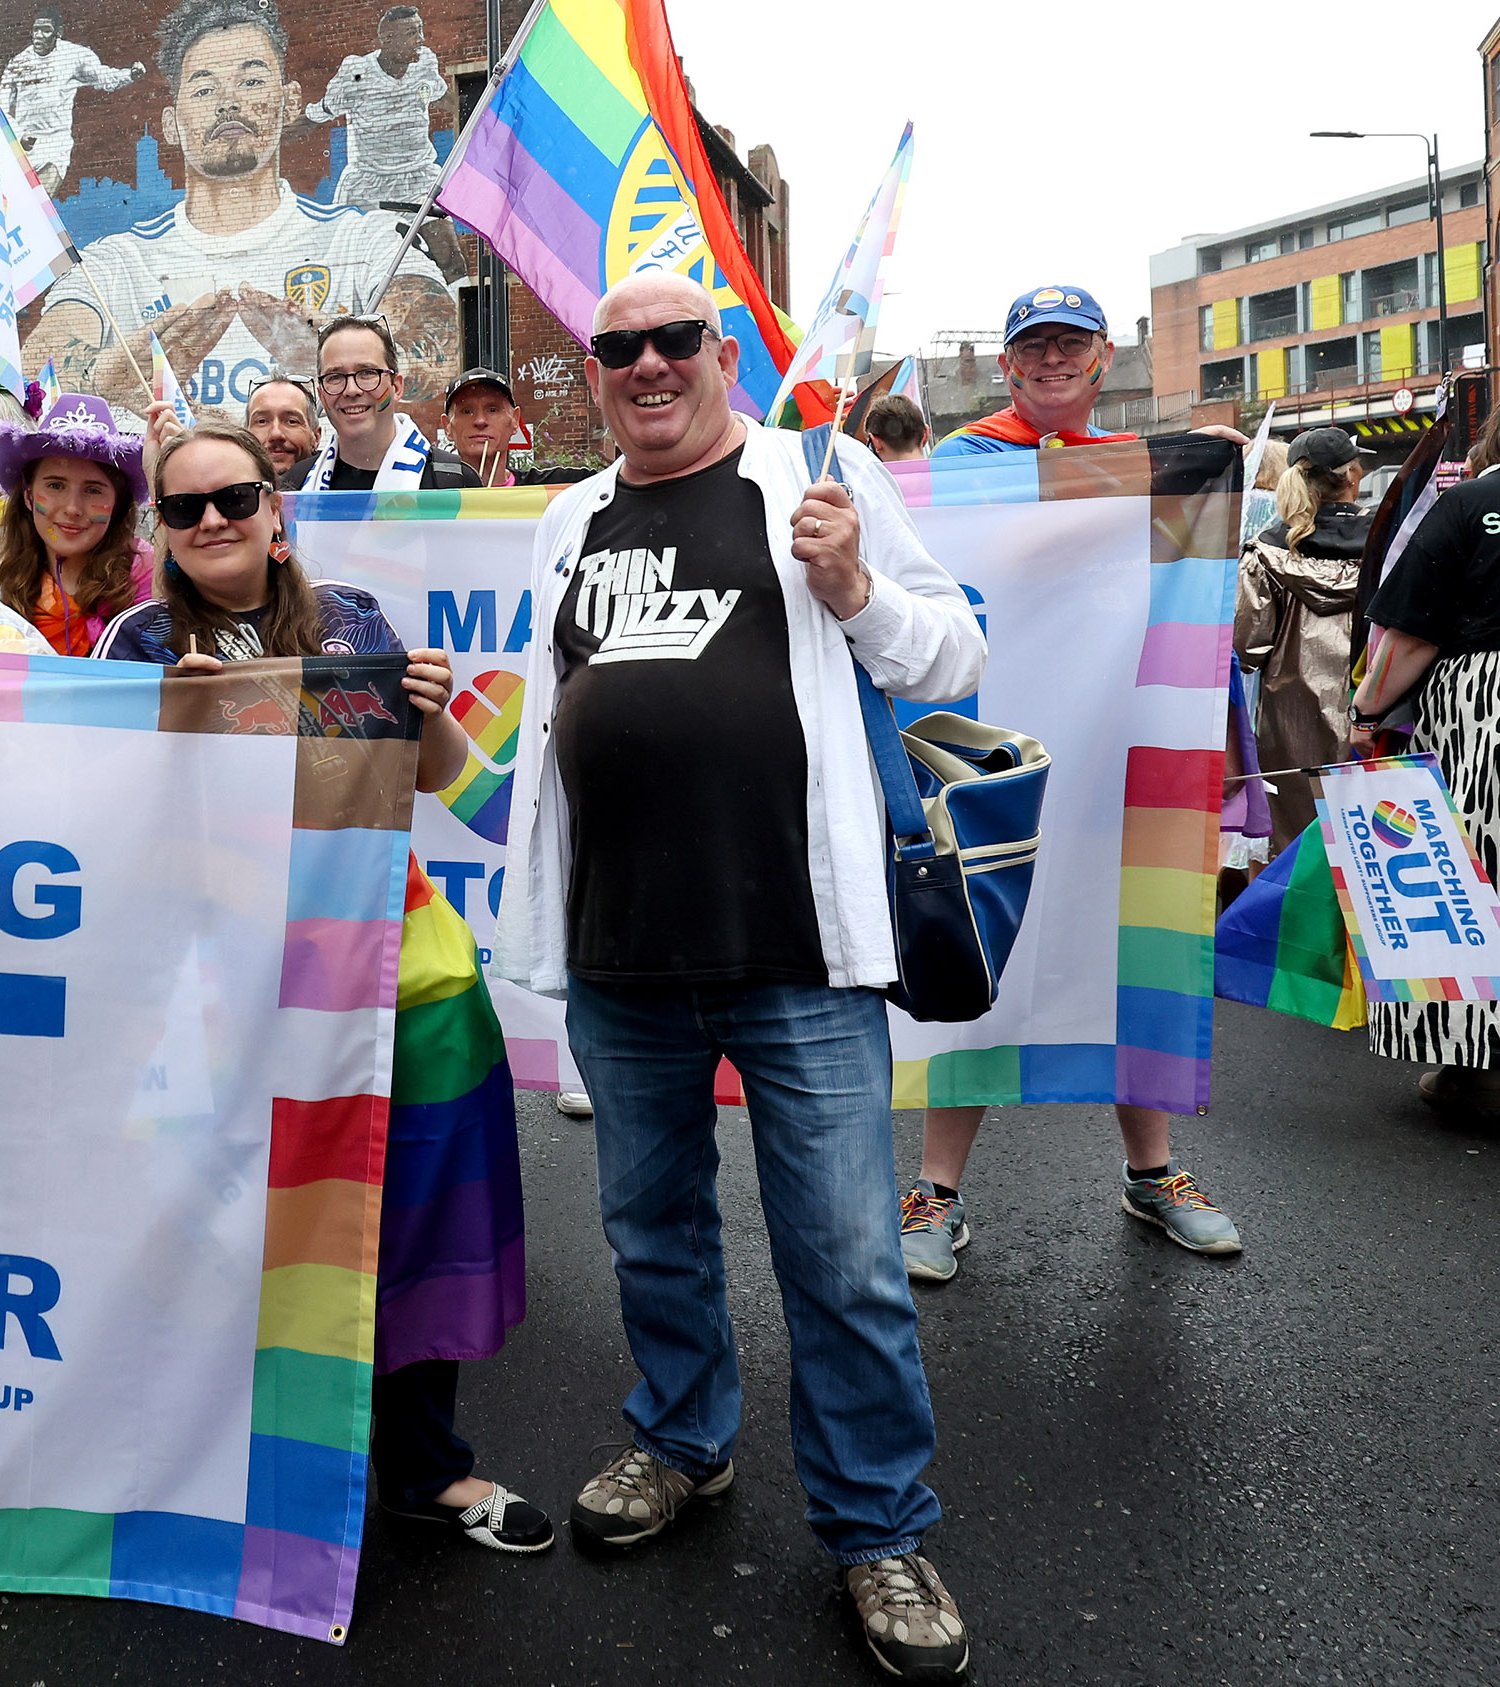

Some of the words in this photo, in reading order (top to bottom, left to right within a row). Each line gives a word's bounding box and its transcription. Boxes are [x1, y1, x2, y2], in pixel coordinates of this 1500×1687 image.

[575, 547, 677, 639] THIN
[588, 589, 742, 667] LIZZY
[1348, 805, 1409, 950] TOGETHER
[1361, 876, 1378, 923] SUPPORTERS
[1375, 923, 1386, 946] GROUP
[1412, 799, 1486, 946] MARCHING
